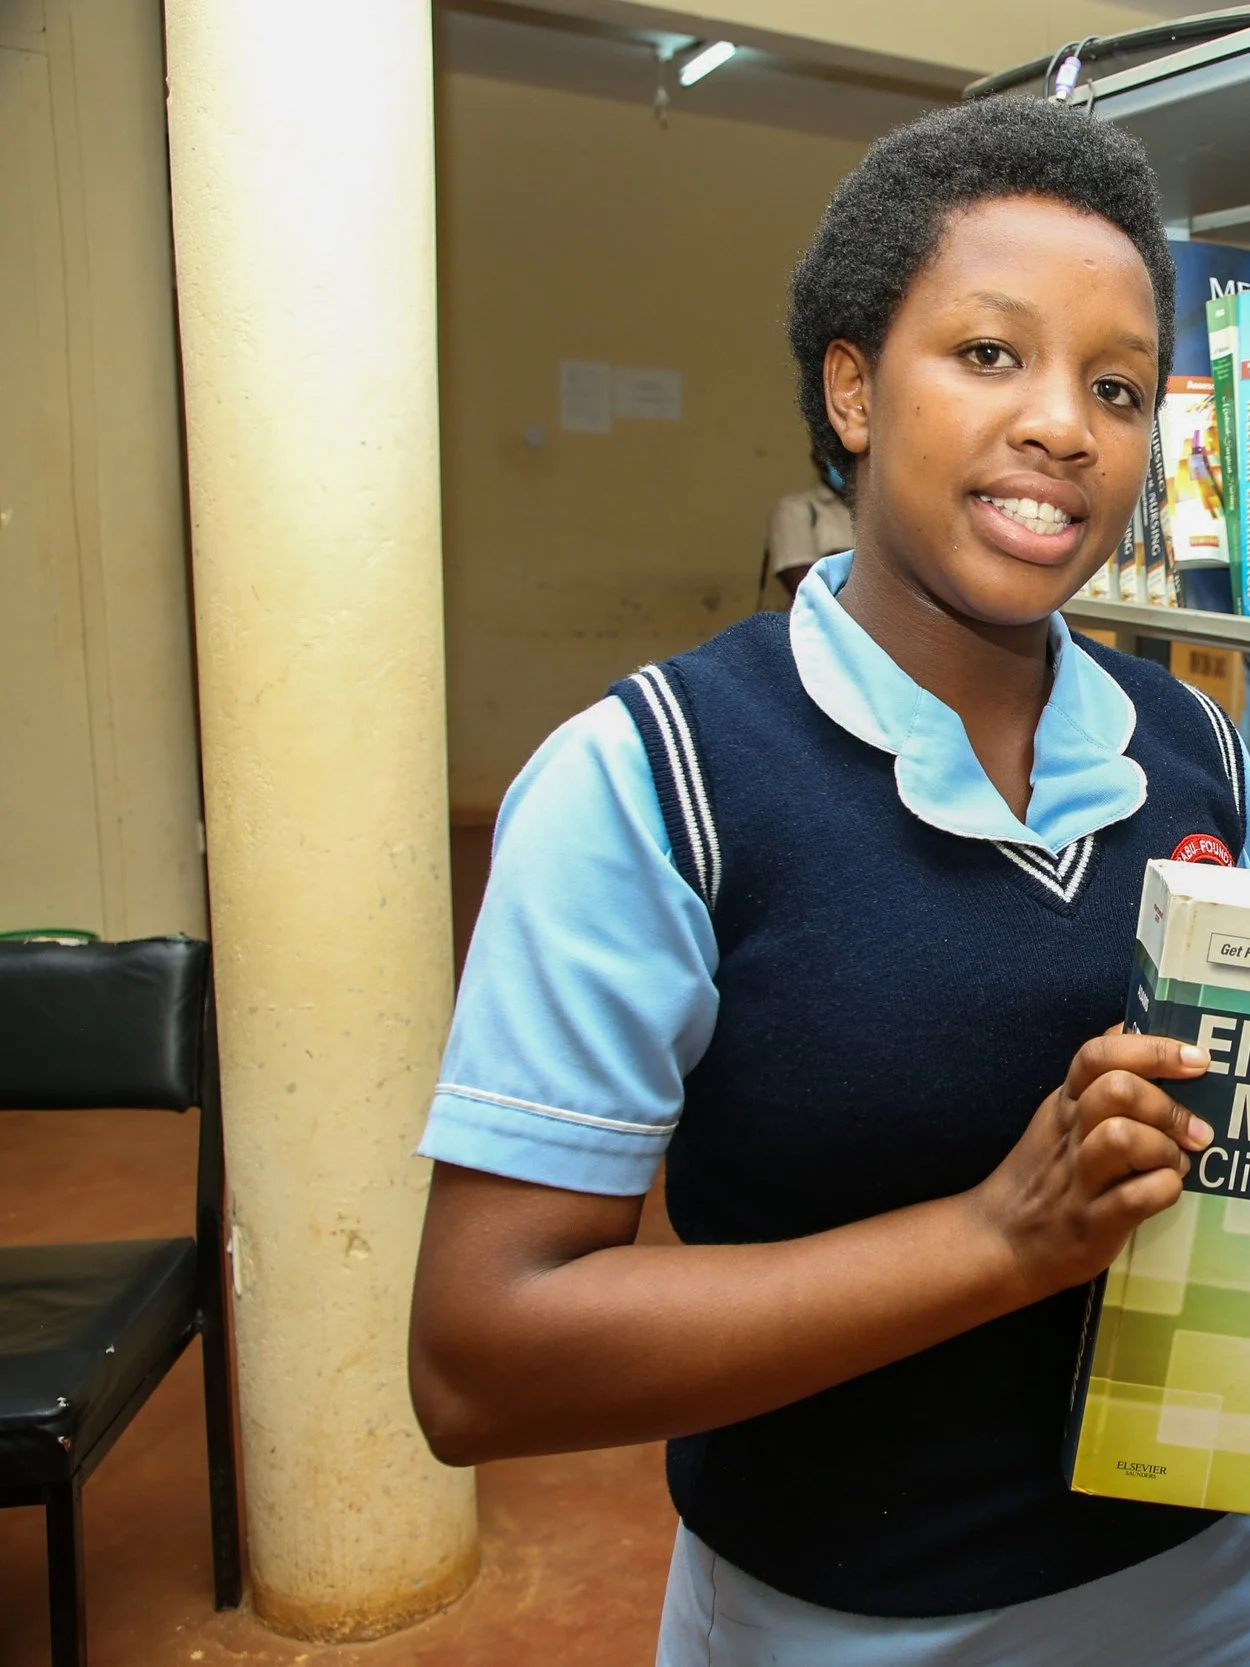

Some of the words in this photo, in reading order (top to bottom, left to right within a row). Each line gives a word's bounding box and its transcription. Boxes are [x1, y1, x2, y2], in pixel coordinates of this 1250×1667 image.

[1199, 839, 1234, 867] FOUND
[1220, 943, 1243, 958] Get
[1117, 1460, 1167, 1475] ELSEVIER
[1125, 1471, 1157, 1480] SAUNDERS
